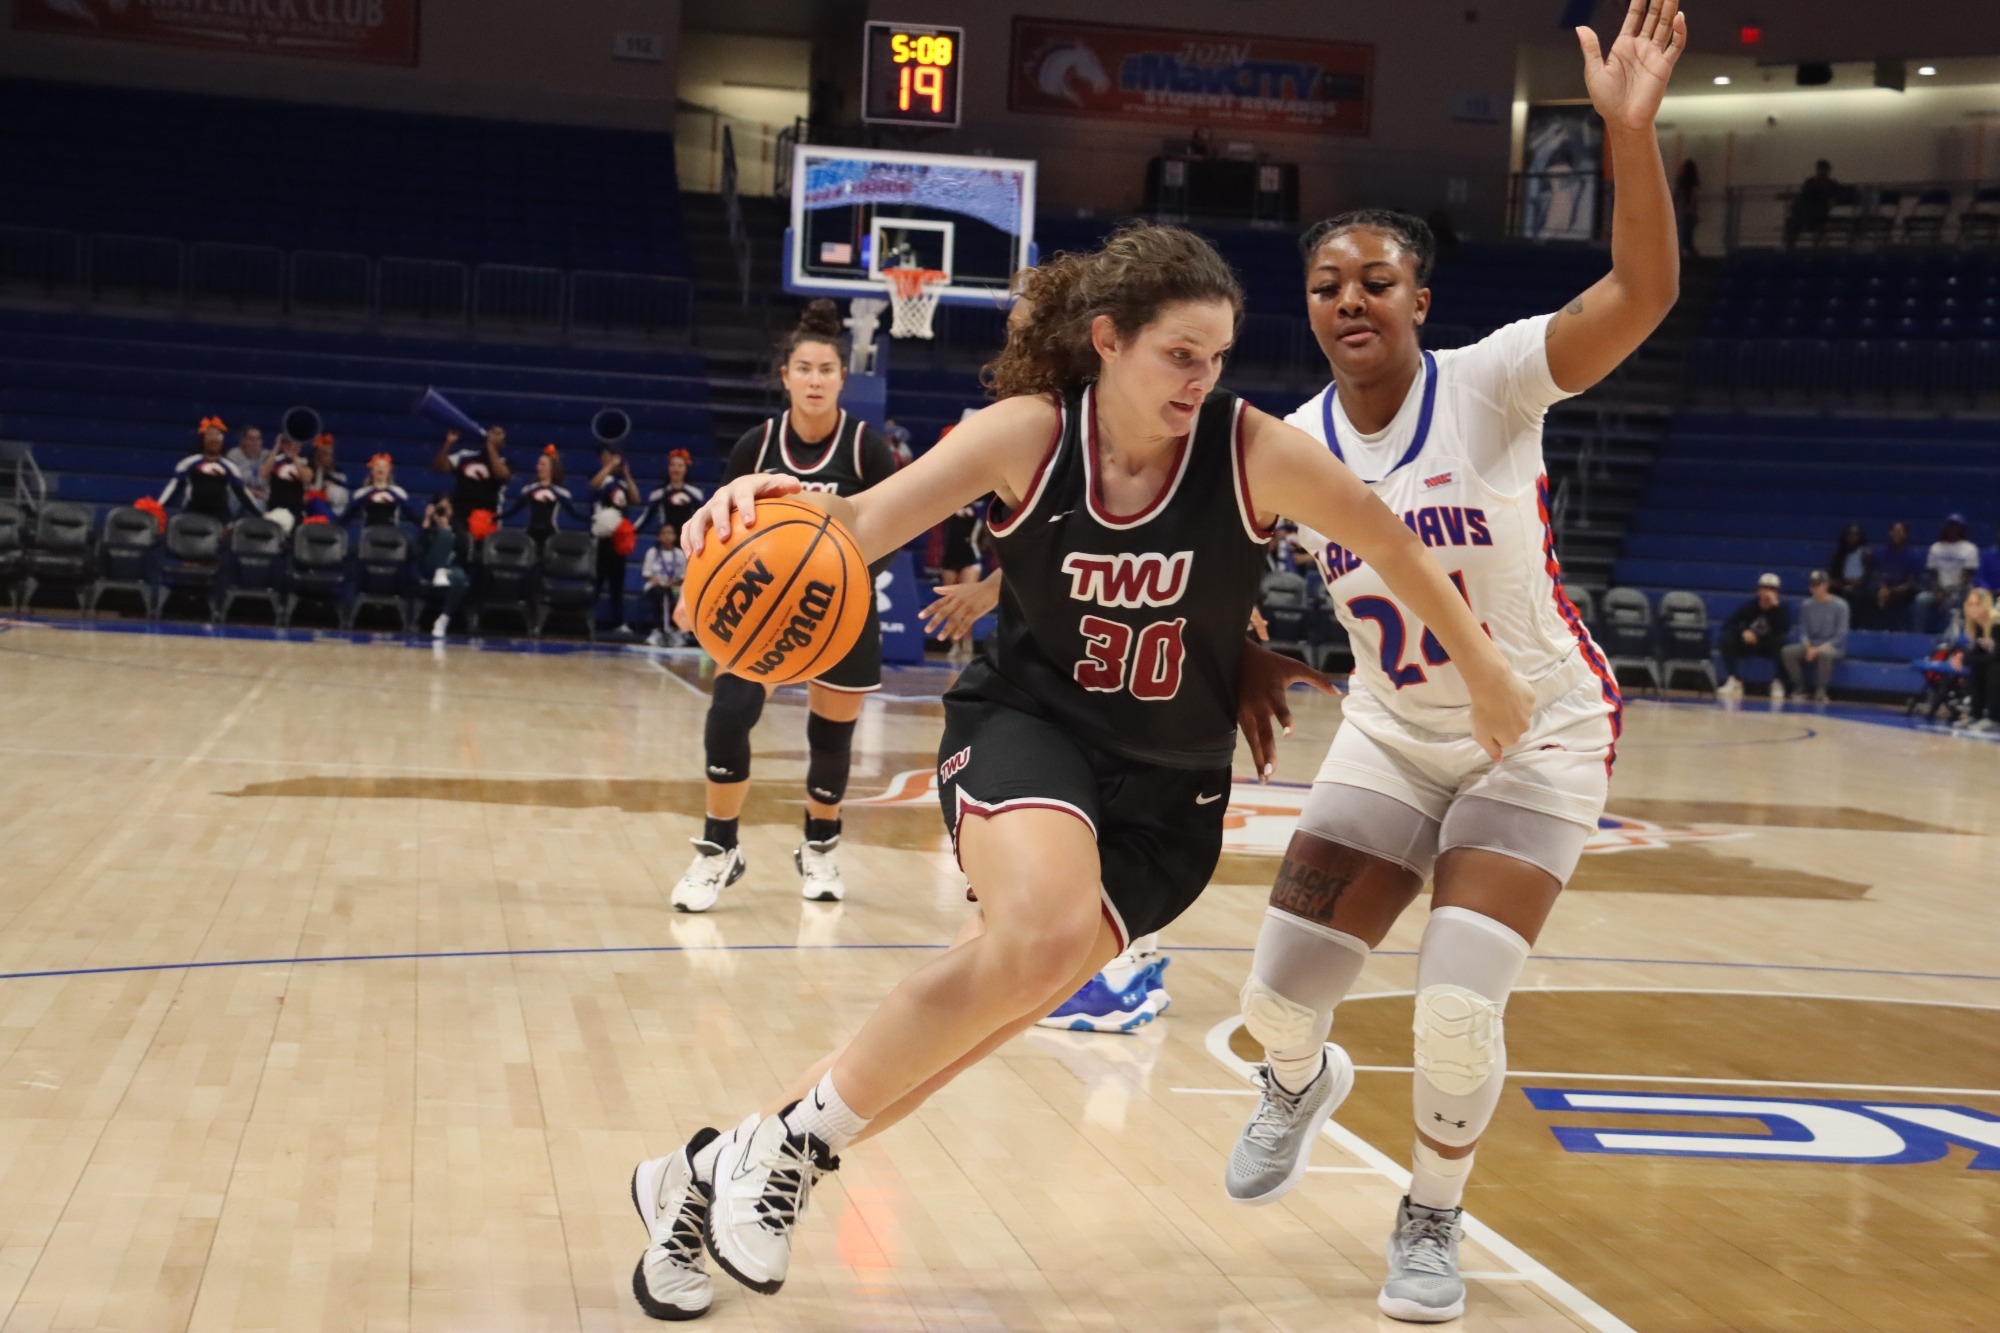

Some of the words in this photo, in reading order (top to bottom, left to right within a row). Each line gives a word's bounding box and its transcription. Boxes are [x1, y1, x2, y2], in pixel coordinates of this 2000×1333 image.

[891, 33, 953, 66] 5:08
[899, 65, 944, 114] 19
[709, 559, 775, 643] NCAA
[1061, 551, 1194, 609] TWU
[747, 580, 837, 676] Wilson
[1073, 615, 1187, 701] 30
[940, 745, 971, 784] TWU
